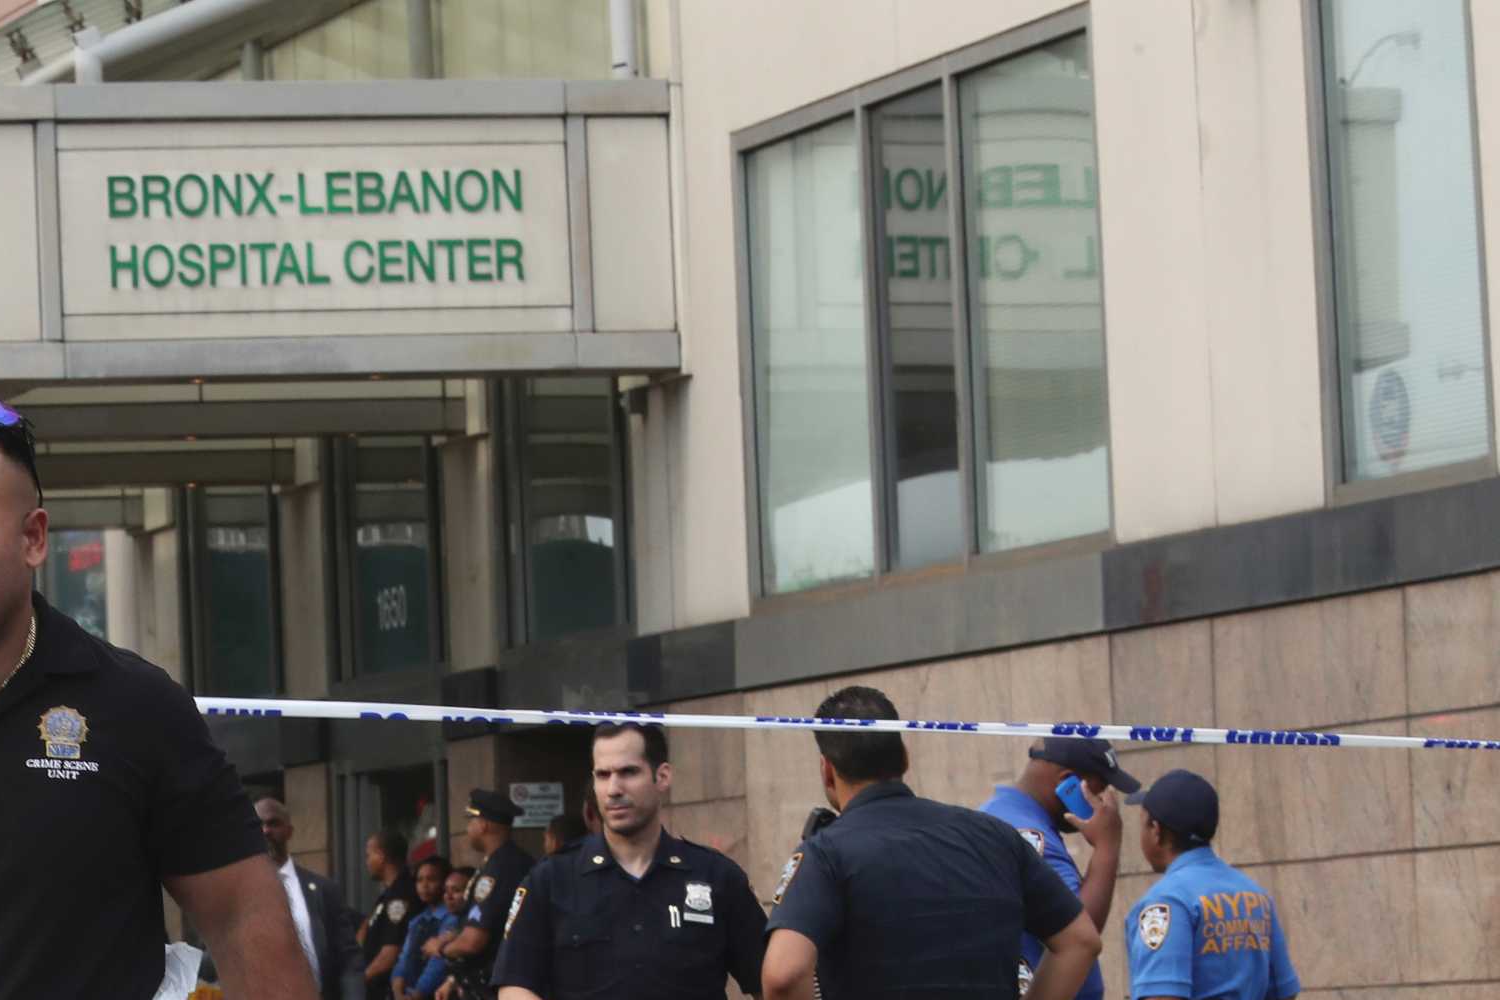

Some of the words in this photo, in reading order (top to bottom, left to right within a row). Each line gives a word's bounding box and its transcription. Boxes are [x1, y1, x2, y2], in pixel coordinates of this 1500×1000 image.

[106, 169, 524, 219] BRONX-LEBANON
[109, 242, 331, 289] HOSPITAL
[343, 238, 526, 284] CENTER
[25, 758, 63, 769] CRIME
[63, 760, 99, 772] SCENE
[47, 769, 80, 780] UNIT
